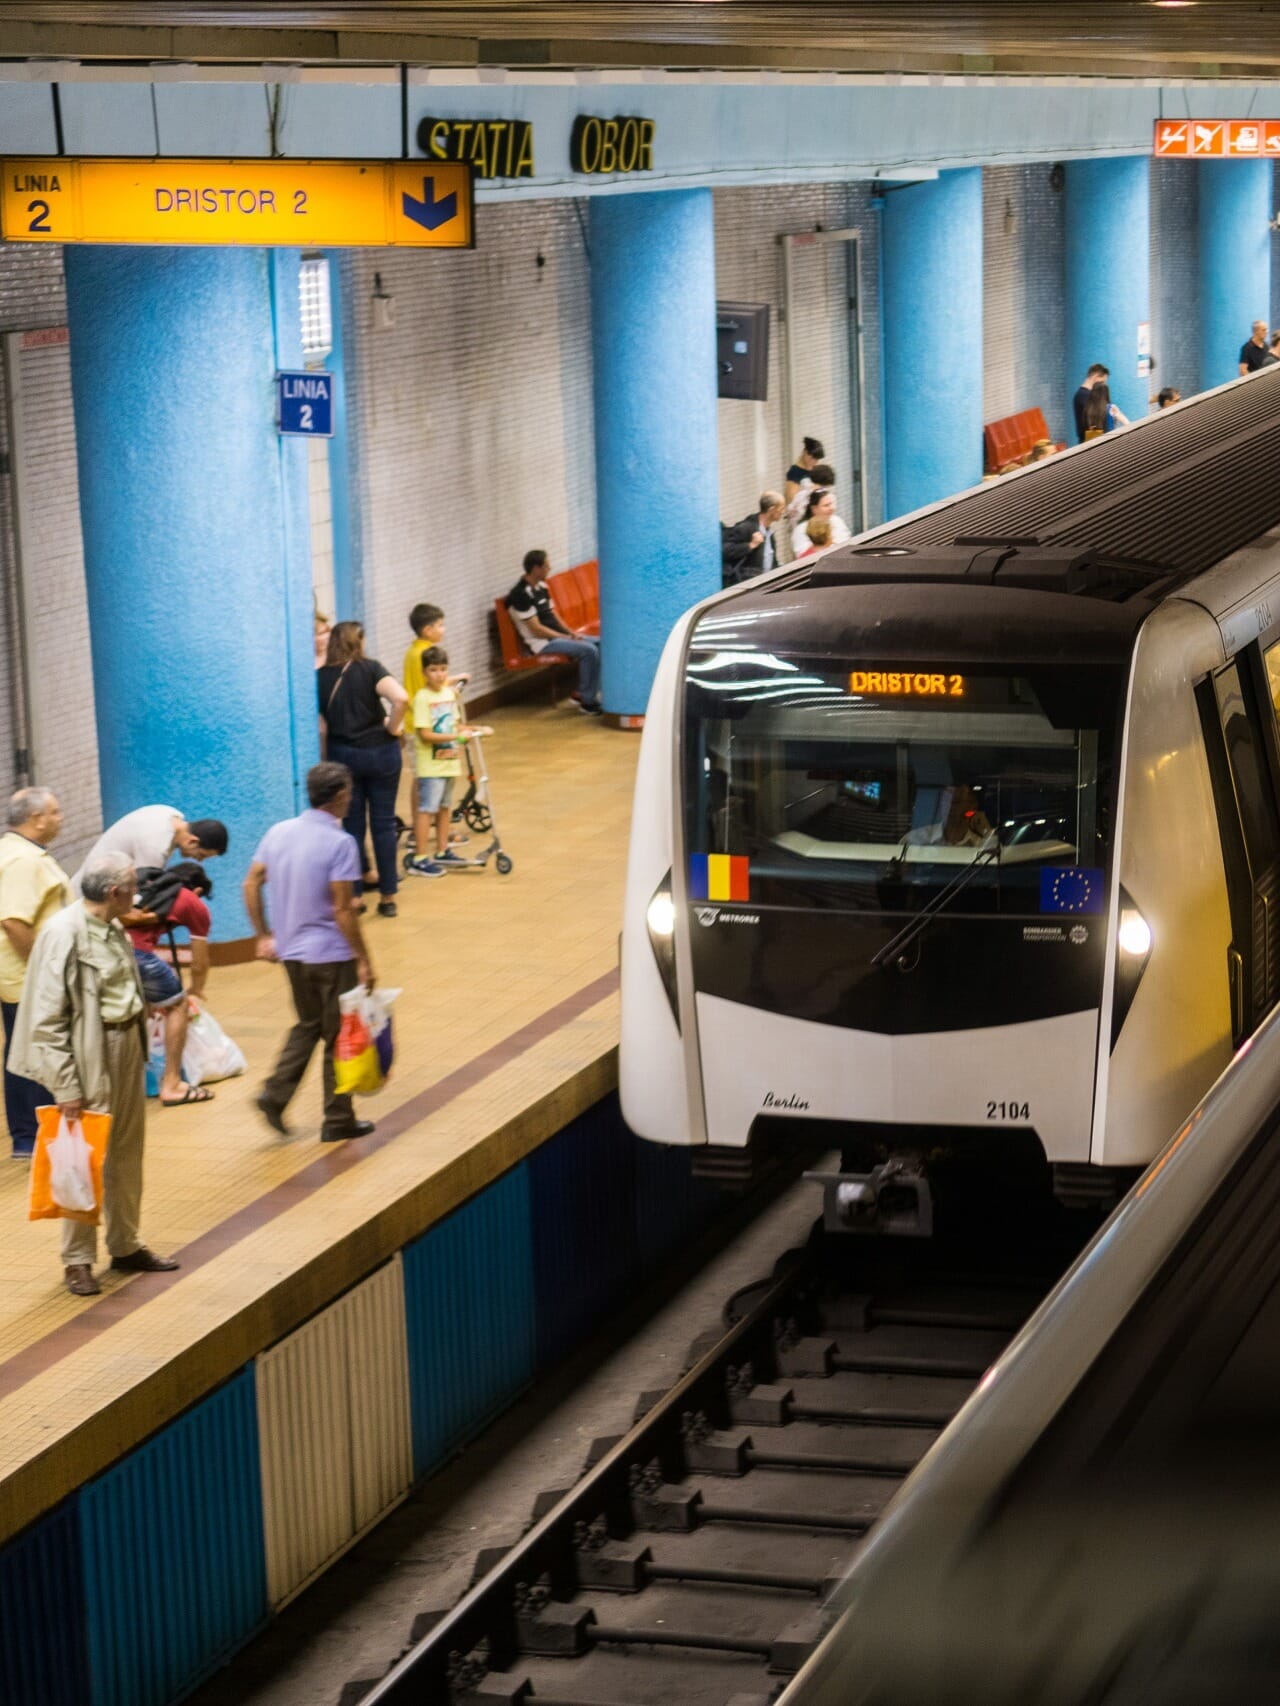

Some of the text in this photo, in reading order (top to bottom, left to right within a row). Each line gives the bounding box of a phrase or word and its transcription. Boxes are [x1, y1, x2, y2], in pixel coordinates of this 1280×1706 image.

[575, 115, 656, 174] OBOR
[14, 175, 61, 192] LINIA
[155, 188, 308, 214] DRISTOR 2
[27, 199, 52, 232] 2
[283, 378, 329, 400] LINIA
[299, 404, 314, 430] 2
[850, 671, 964, 696] DRISTOR 2
[762, 1090, 810, 1110] Berlin
[986, 1100, 1030, 1120] 2104
